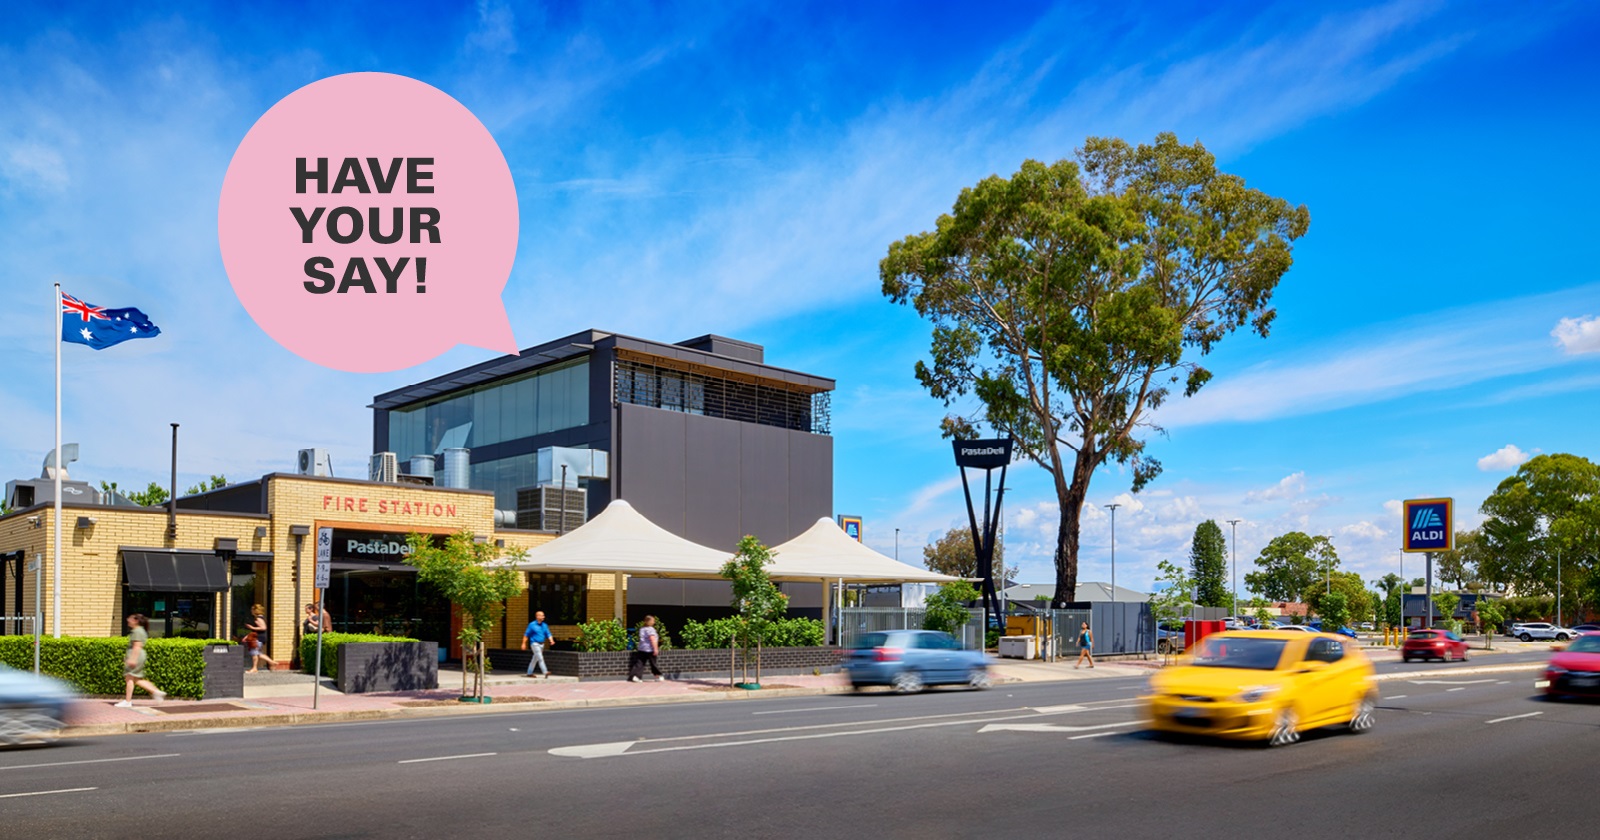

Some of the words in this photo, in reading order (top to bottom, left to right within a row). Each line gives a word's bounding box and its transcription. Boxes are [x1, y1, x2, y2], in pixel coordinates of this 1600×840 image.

[961, 447, 1005, 456] PastaDeli
[323, 495, 368, 512] FIRE
[378, 500, 456, 516] STATION
[1411, 530, 1444, 541] ALDI
[317, 549, 330, 558] LANE
